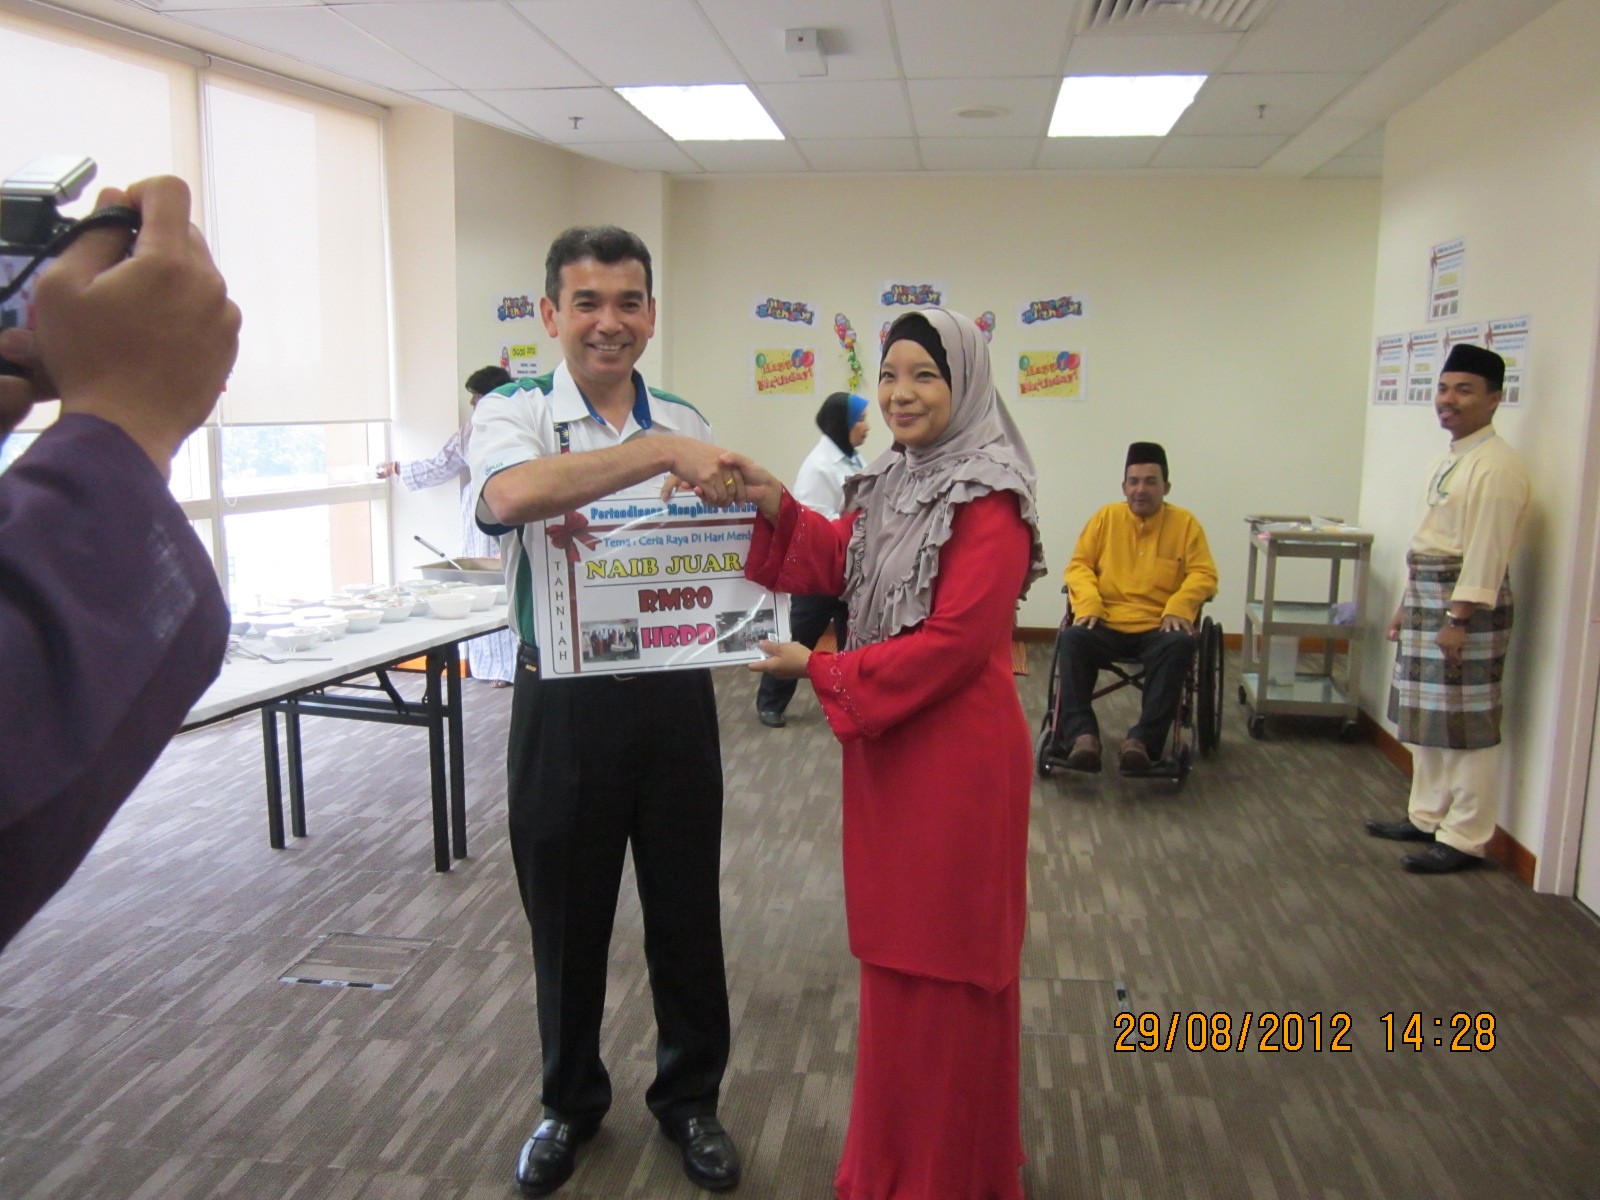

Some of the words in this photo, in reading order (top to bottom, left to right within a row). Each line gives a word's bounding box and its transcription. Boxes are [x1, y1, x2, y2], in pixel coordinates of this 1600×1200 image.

[763, 357, 801, 373] Happy
[639, 536, 663, 546] Ceria
[666, 534, 688, 547] Raya
[692, 533, 702, 543] Di
[705, 531, 724, 543] Hari
[727, 530, 751, 541] Merd
[586, 558, 659, 579] NAIB
[666, 553, 744, 574] JUAR
[554, 561, 567, 661] TAHNIAH
[638, 586, 713, 614] RM80
[641, 623, 715, 649] HRDD
